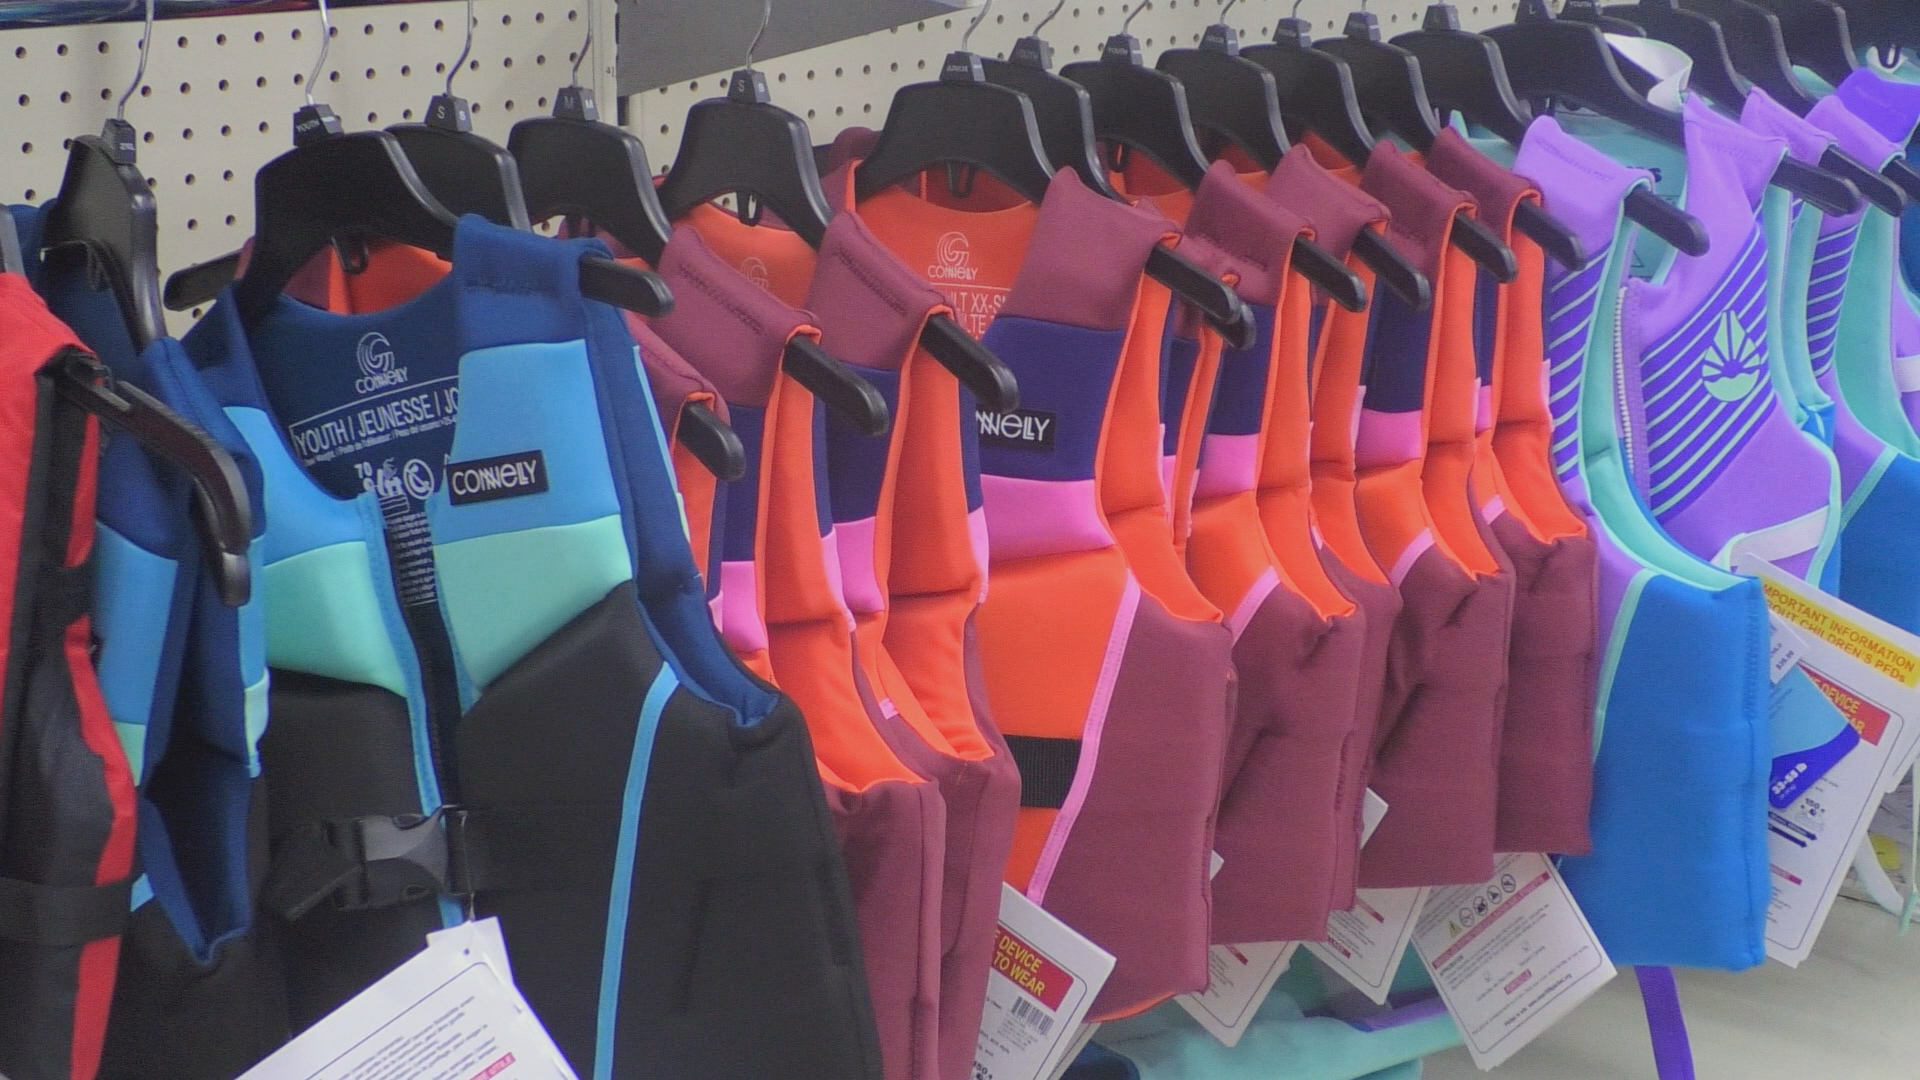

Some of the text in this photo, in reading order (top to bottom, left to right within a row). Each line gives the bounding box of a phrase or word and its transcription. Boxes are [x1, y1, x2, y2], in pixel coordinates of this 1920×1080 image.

[436, 106, 446, 120] S
[459, 110, 467, 121] S
[970, 291, 1007, 314] XX-S
[294, 418, 350, 456] YOUTH
[357, 393, 435, 438] JEUNESSE
[444, 386, 460, 415] JO
[1763, 583, 1916, 673] MPORTANT INFORMATION
[1768, 600, 1800, 622] OUT
[1874, 659, 1906, 683] PFDs
[994, 951, 1046, 997] TO WEAR
[998, 935, 1043, 974] DEVICE
